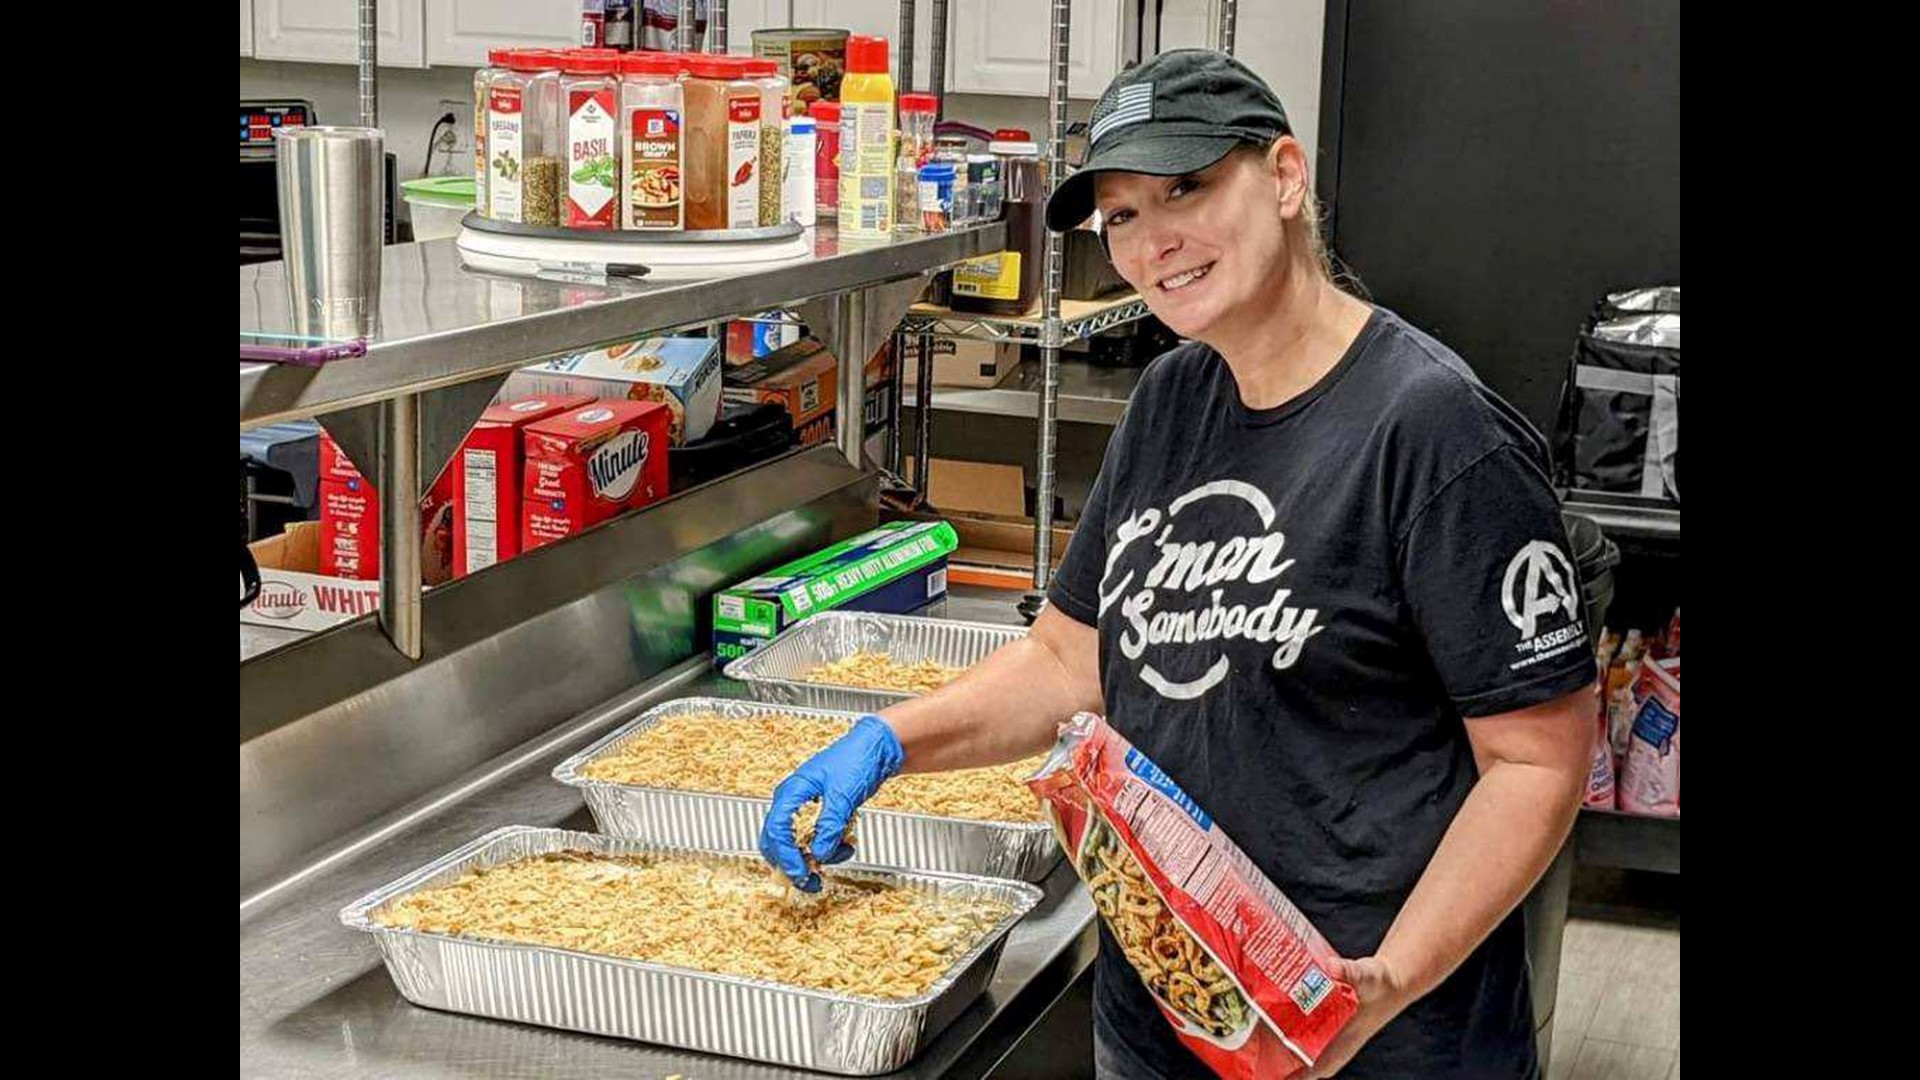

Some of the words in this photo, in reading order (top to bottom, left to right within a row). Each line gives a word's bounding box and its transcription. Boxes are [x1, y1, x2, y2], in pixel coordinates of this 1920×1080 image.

[573, 138, 609, 161] BASIL
[634, 141, 676, 152] BROWN
[311, 297, 366, 316] YETI
[591, 432, 648, 491] Minute
[1120, 589, 1325, 669] Somebody
[1515, 641, 1534, 652] THE
[1534, 620, 1583, 653] ASSEMBLY
